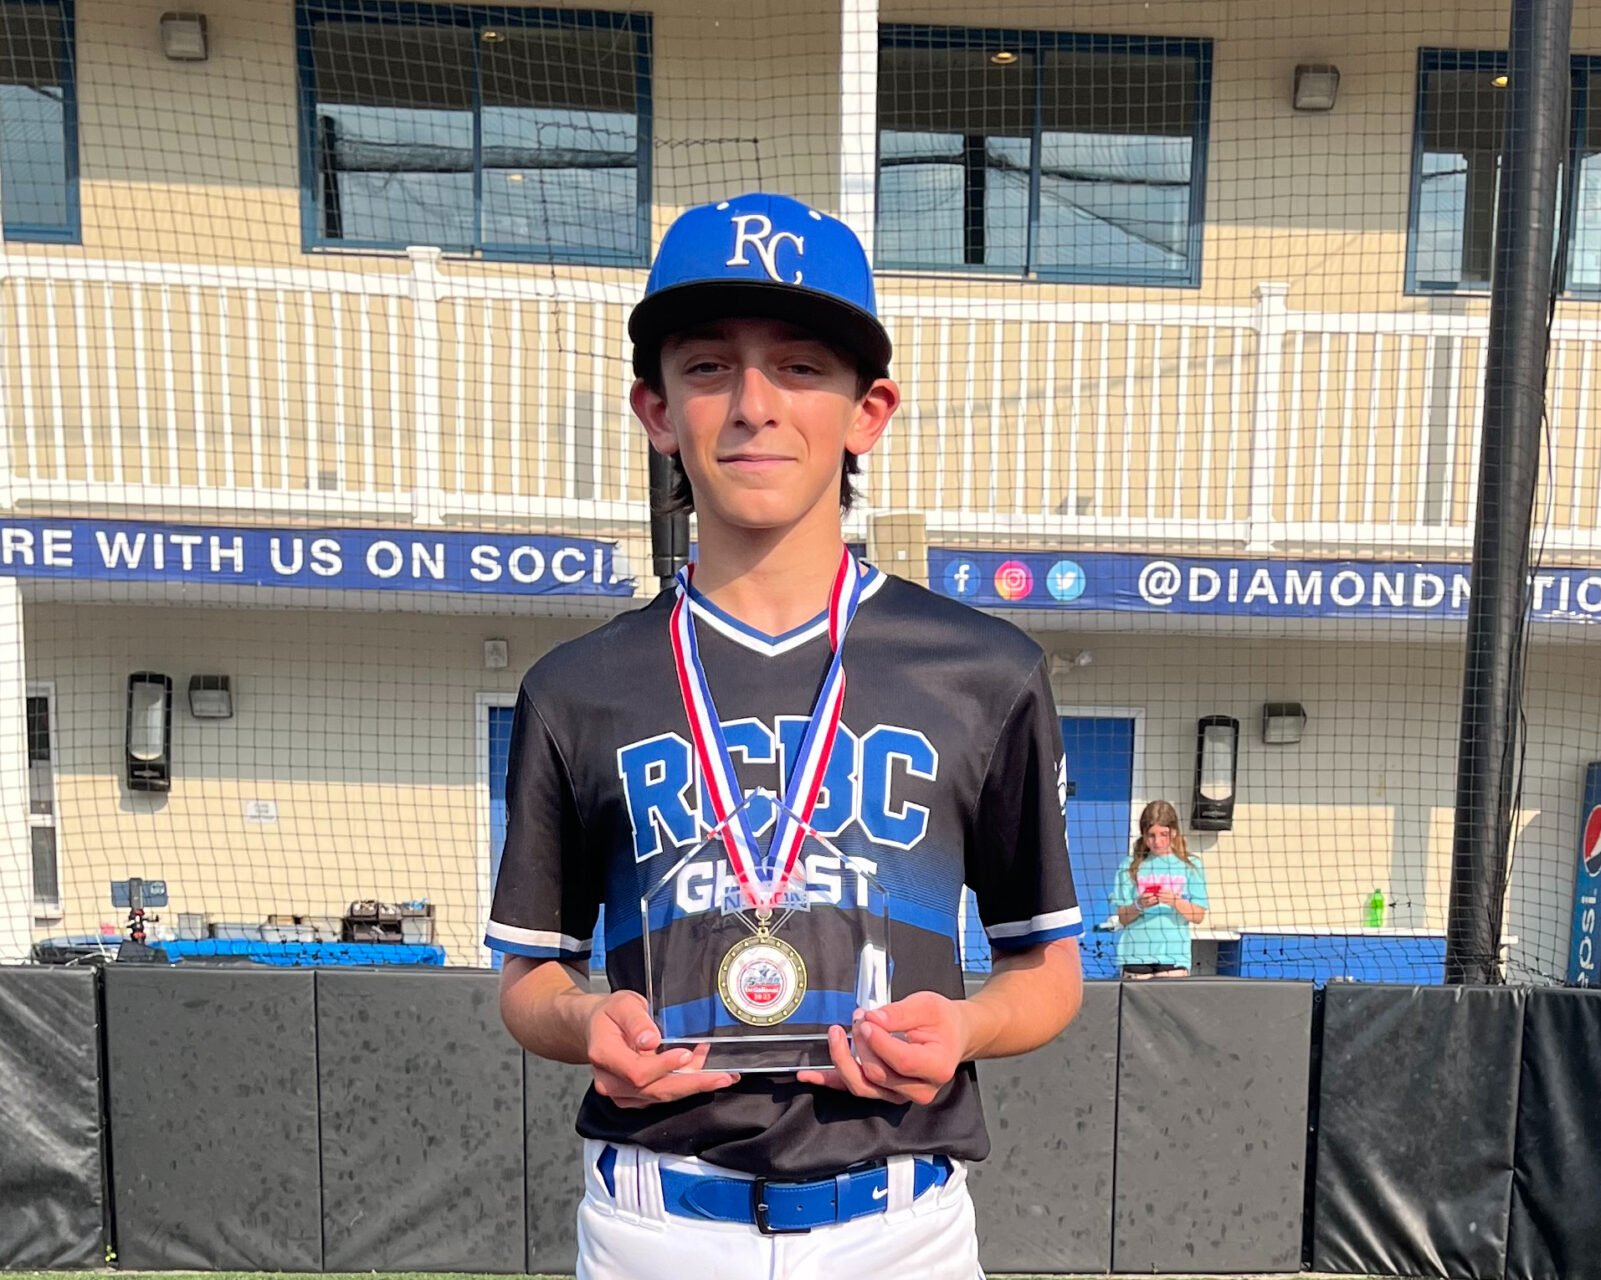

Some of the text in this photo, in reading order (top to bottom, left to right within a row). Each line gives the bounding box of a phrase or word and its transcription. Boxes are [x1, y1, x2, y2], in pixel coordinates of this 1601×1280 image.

[726, 213, 805, 286] RC
[1, 527, 619, 585] RE WITH US ON SOCI
[616, 715, 939, 864] RCBC
